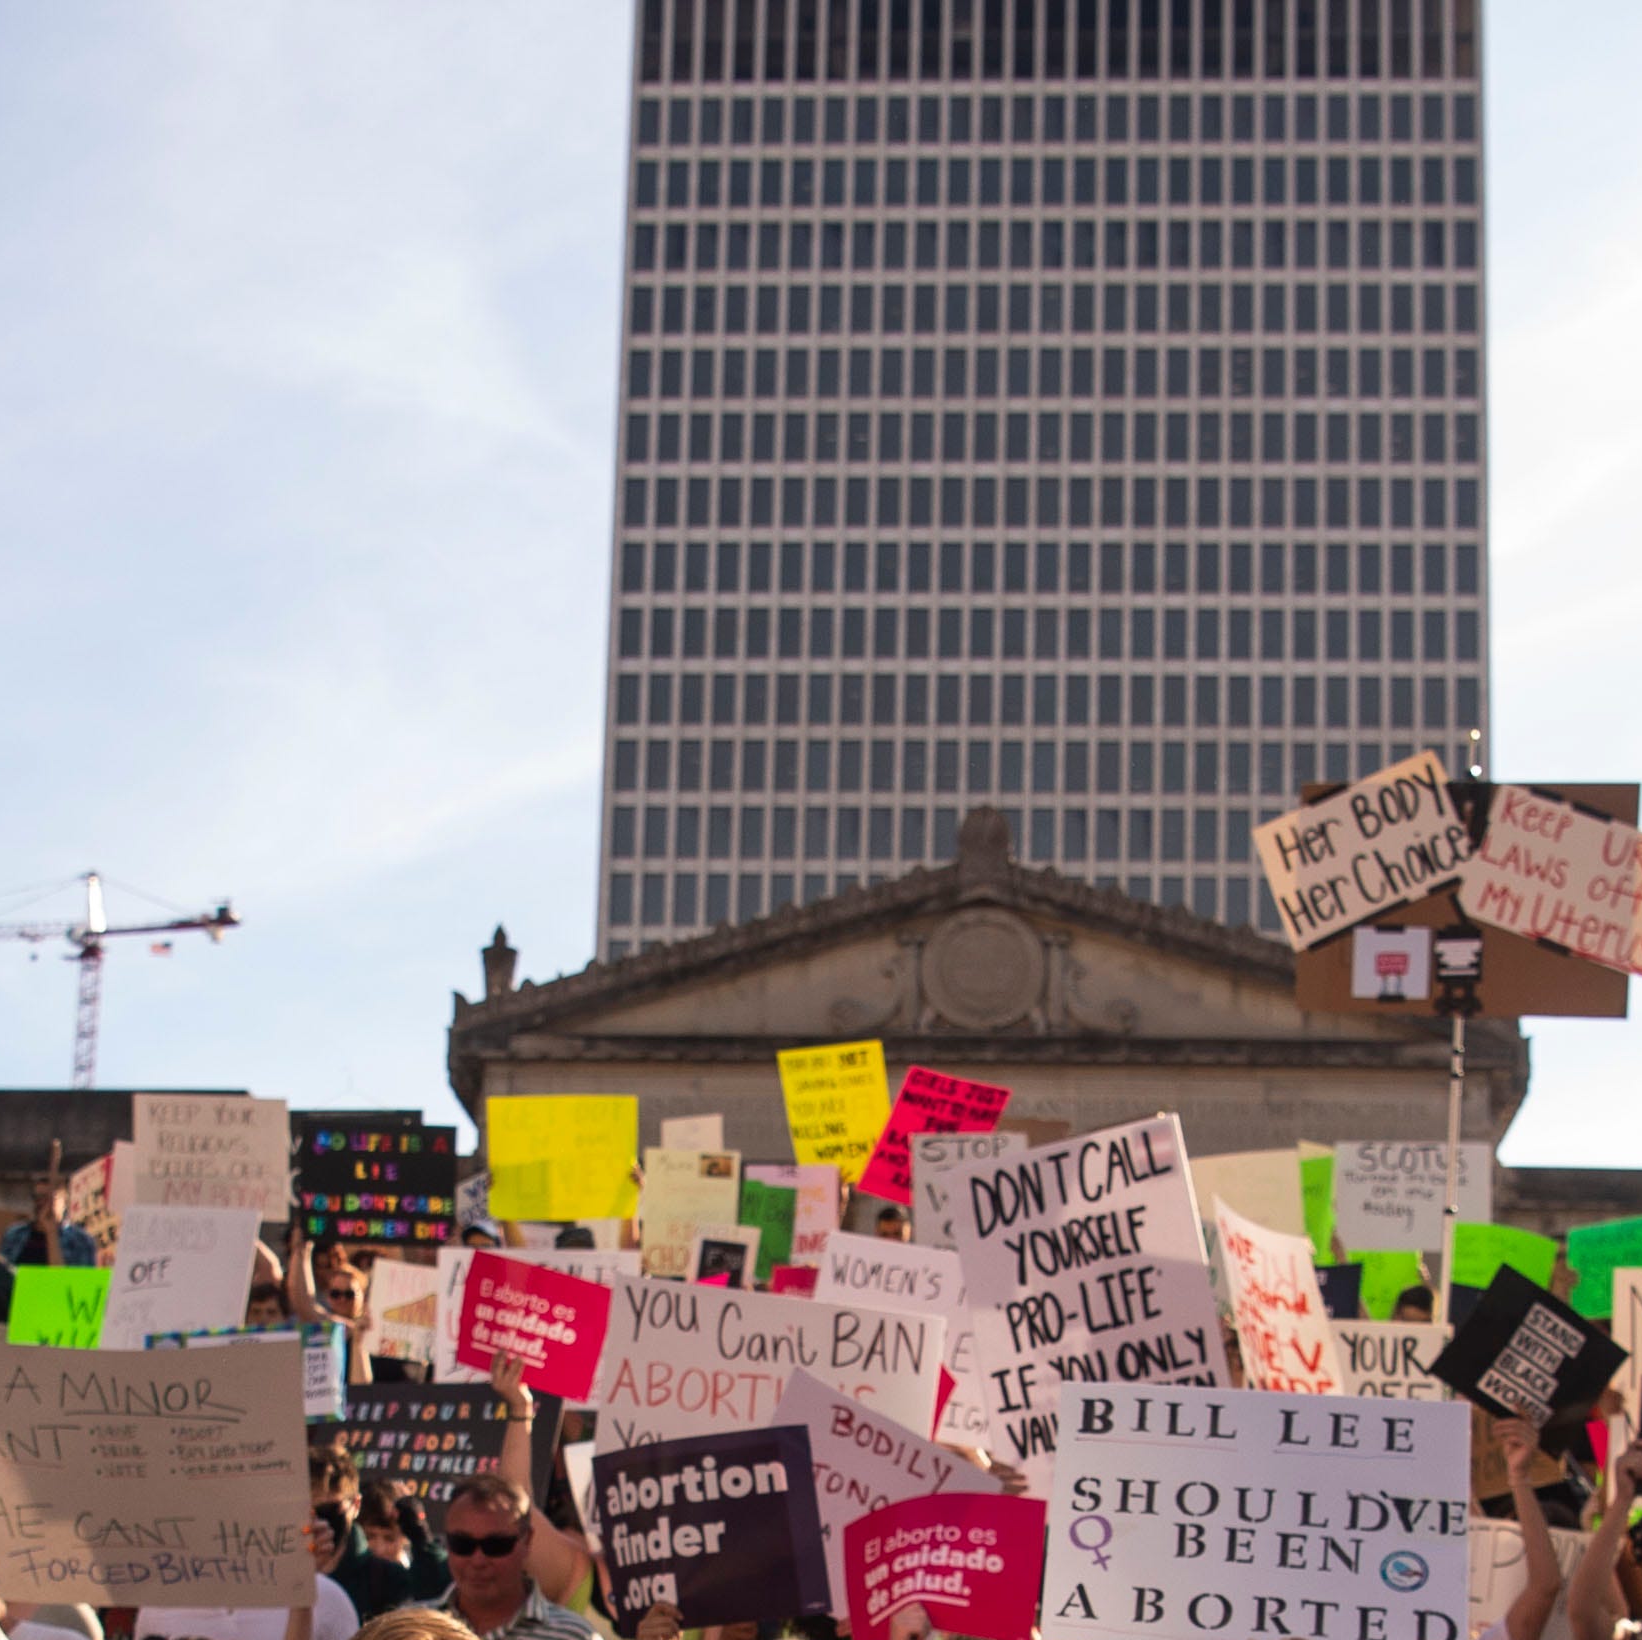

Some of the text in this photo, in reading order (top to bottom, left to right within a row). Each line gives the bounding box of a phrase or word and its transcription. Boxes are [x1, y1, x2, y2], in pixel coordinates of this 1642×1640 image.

[1275, 763, 1445, 872] Her BODY
[1279, 825, 1475, 937] Her Choice
[1479, 835, 1569, 890] LAWS
[349, 1131, 393, 1154] LIFE
[433, 1136, 449, 1153] A
[919, 1134, 1012, 1164] STOP
[354, 1160, 399, 1182] LIE
[1078, 1131, 1173, 1203] CALL
[302, 1193, 342, 1212] YOU
[401, 1195, 454, 1216] CARE
[336, 1219, 410, 1237] WOMEN
[414, 1221, 450, 1240] DIE
[1004, 1205, 1147, 1286] YOURSELF
[129, 1257, 172, 1285] OFF
[830, 1254, 945, 1302] WOMEN'S
[493, 1283, 551, 1315] aborto
[551, 1303, 577, 1323] es
[495, 1307, 577, 1346] cuidado
[830, 1310, 926, 1377] BAN
[1340, 1331, 1430, 1376] YOUR
[1512, 1329, 1562, 1371] WITH
[1528, 1308, 1585, 1357] STAND
[5, 1364, 42, 1406] A
[59, 1371, 248, 1416] MINOR
[990, 1327, 1208, 1415] IF YOU ONLY
[1497, 1350, 1556, 1400] BLACK
[345, 1402, 472, 1422] KEEP YOUR
[1077, 1397, 1415, 1454] BILL LEE
[335, 1429, 374, 1449] OFF
[378, 1431, 410, 1450] MY
[829, 1403, 953, 1497] BODILY
[606, 1454, 789, 1518] abortion
[73, 1510, 197, 1548] CANT
[213, 1519, 297, 1558] HAVE
[612, 1516, 726, 1568] finder
[864, 1523, 998, 1565] El aborto es
[1173, 1522, 1365, 1576] BEEN
[8, 1545, 152, 1587] FORCED
[864, 1543, 1005, 1590] un cuidado
[866, 1568, 973, 1616] de salud.
